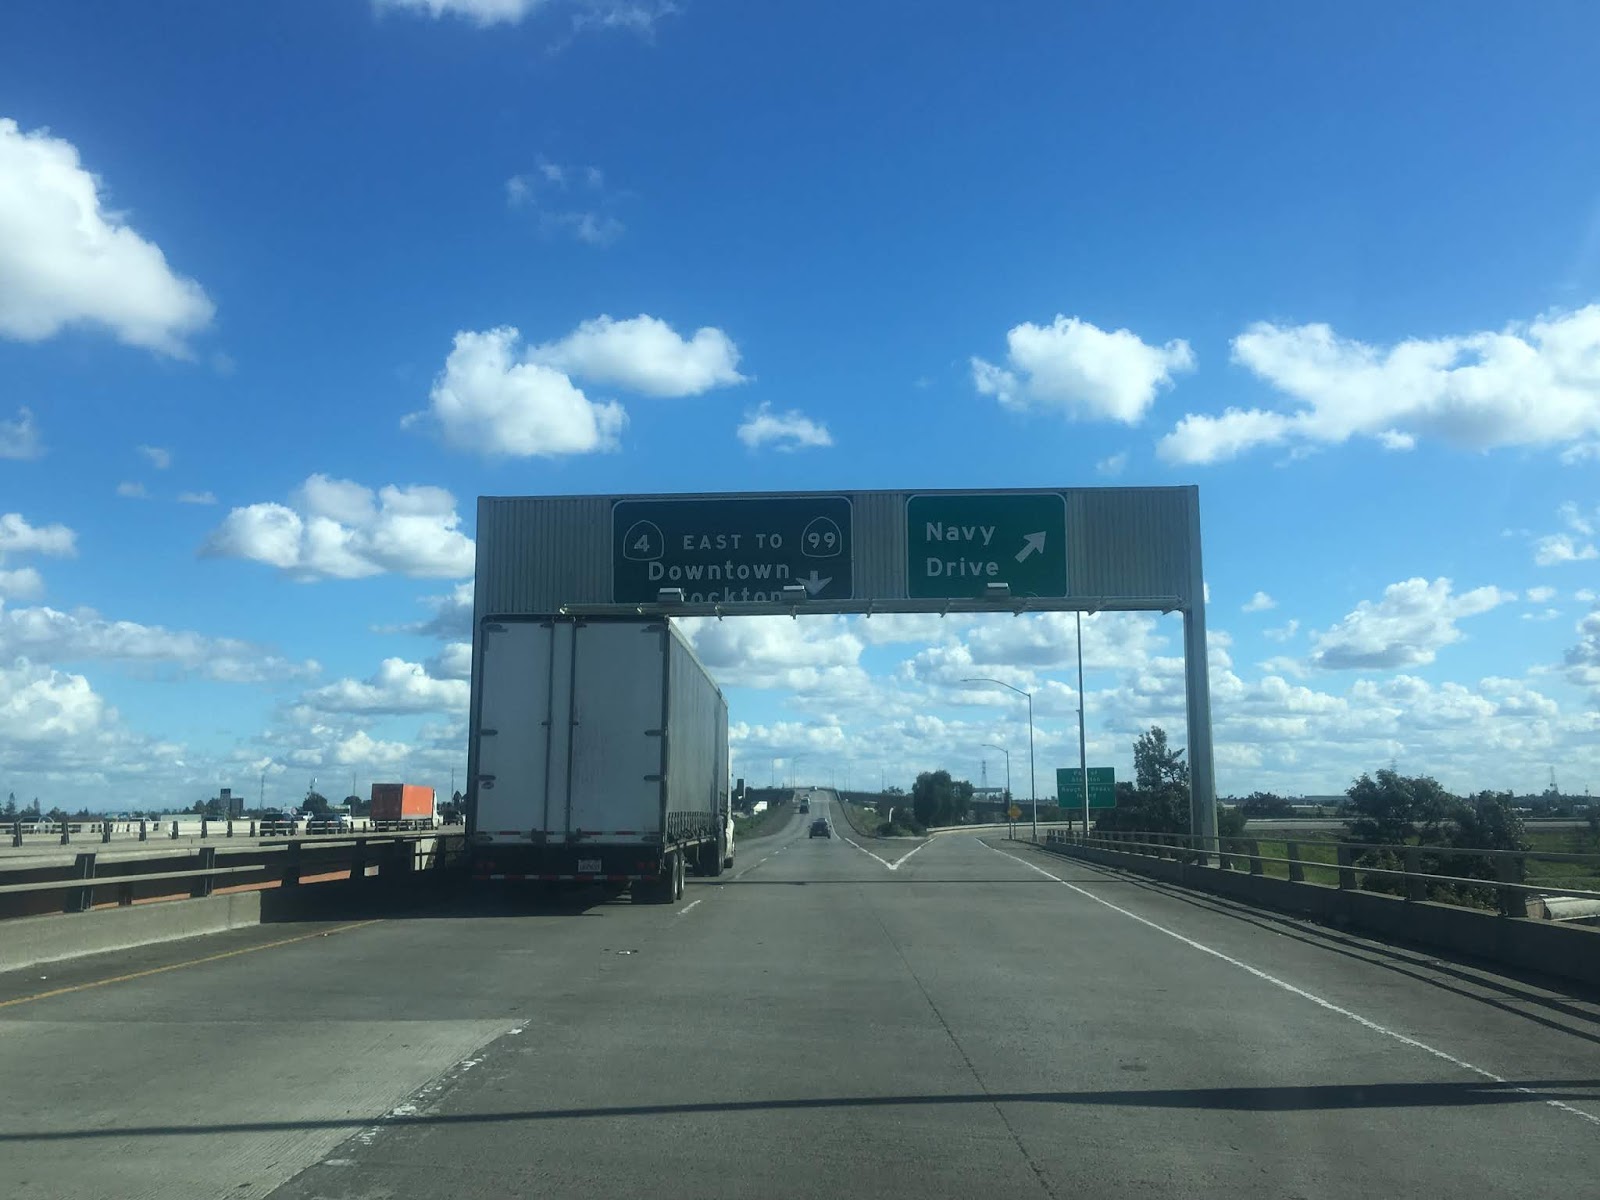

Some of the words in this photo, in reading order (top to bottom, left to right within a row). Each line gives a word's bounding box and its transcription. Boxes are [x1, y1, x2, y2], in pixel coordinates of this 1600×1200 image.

[633, 534, 650, 551] 4
[683, 534, 741, 550] EAST
[755, 533, 783, 549] TO
[807, 531, 836, 549] 99
[925, 521, 996, 545] Navy
[648, 559, 790, 581] Downtown
[926, 557, 999, 577] Drive
